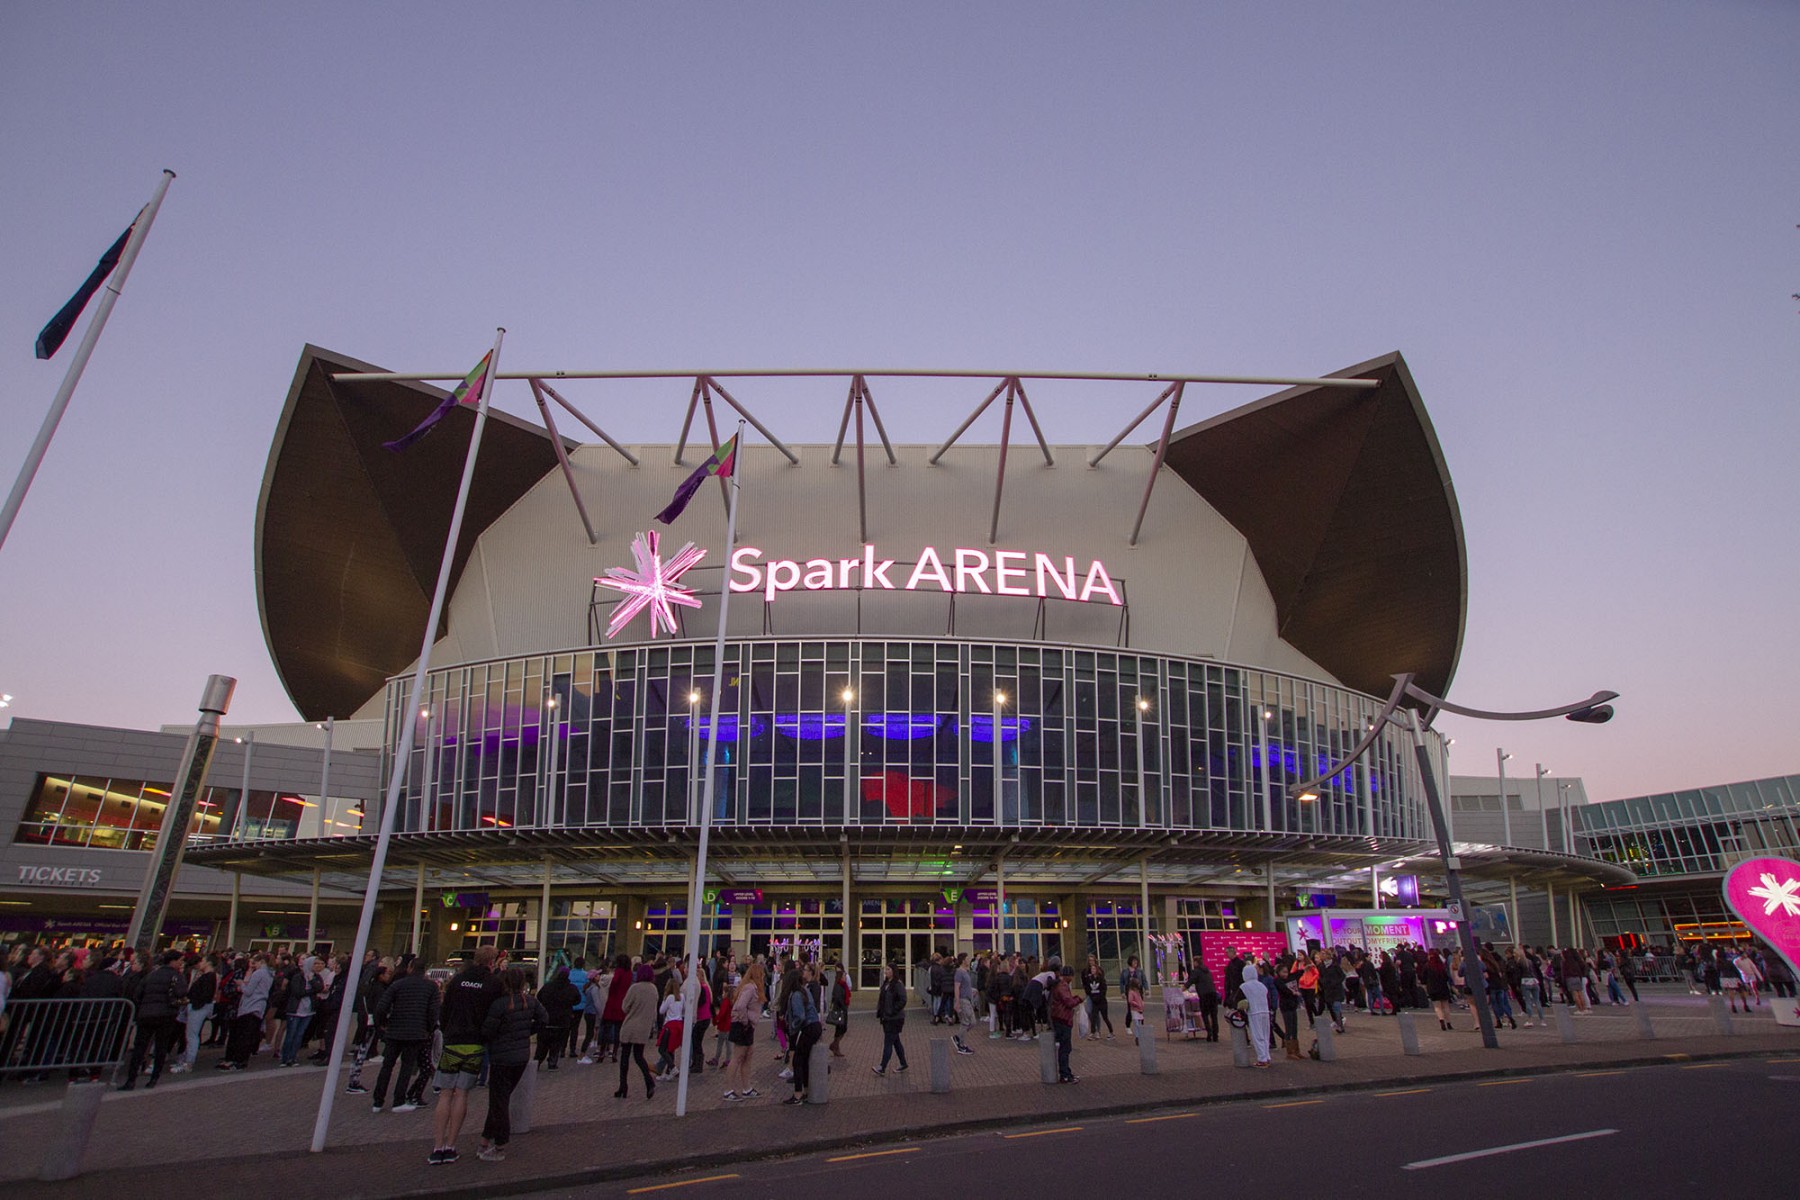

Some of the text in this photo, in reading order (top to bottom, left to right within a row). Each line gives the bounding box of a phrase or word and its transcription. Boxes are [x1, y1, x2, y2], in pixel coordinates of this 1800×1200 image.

[728, 544, 1122, 605] Spark ARENA
[18, 865, 102, 883] TICKETS
[446, 896, 454, 906] C
[707, 892, 716, 902] D
[950, 891, 958, 901] E
[1364, 924, 1408, 935] MOMENT
[460, 980, 483, 989] COACH
